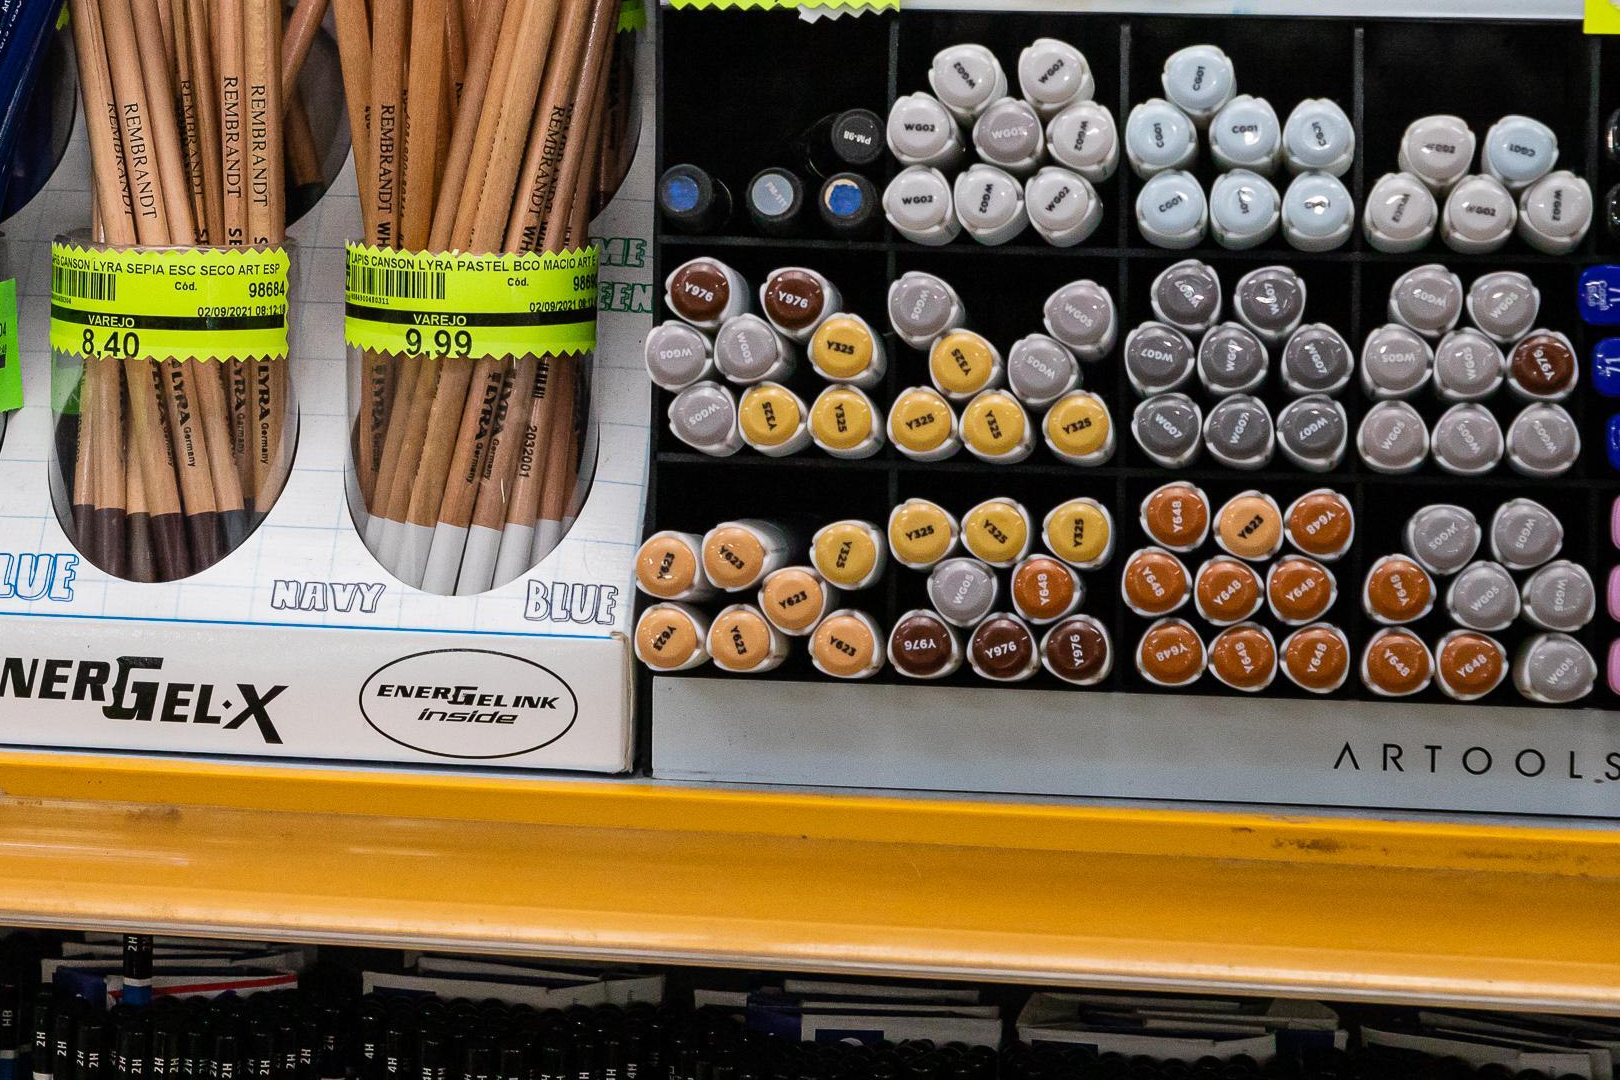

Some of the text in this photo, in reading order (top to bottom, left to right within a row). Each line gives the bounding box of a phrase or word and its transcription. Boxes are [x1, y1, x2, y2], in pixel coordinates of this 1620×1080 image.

[1038, 58, 1066, 86] WG02
[904, 122, 936, 133] WG02
[223, 76, 242, 199] REMBRANDT
[251, 84, 268, 207] REMBRANDT
[124, 102, 158, 219] REMBRANDT
[902, 195, 934, 206] WG02
[60, 257, 90, 271] CANSON
[93, 260, 123, 273] LYRA
[127, 263, 164, 275] SEPIA
[169, 264, 196, 276] ESC
[200, 264, 235, 276] SECO
[238, 264, 260, 276] ART
[263, 263, 281, 275] ESP
[351, 253, 370, 266] LAPIS
[371, 256, 415, 270] CANSON
[418, 259, 453, 271] LYRA
[457, 260, 509, 272] PASTEL
[513, 260, 540, 271] BCO
[543, 258, 576, 271] MACIO
[174, 281, 285, 298] Cód. 98684
[507, 277, 529, 287] Cód.
[684, 281, 714, 303] Y976
[778, 290, 809, 309] Y976
[88, 314, 135, 328] VAREJO
[197, 307, 252, 317] 02/09/2021
[412, 313, 467, 326] VAREJO
[82, 328, 140, 359] 8,40
[826, 340, 855, 355] Y325
[258, 365, 271, 465] LYRA Germany
[905, 413, 934, 430] Y325
[519, 425, 537, 478] 2032001
[905, 524, 935, 542] Y325
[718, 545, 746, 570] Y623
[1213, 578, 1243, 605] Y648
[1286, 577, 1316, 603] Y648
[272, 579, 618, 625] NAVY BLUE
[778, 590, 808, 610] Y623
[985, 641, 1016, 660] Y976
[512, 693, 558, 709] INK
[418, 706, 518, 725] inside
[35, 1030, 47, 1048] 2H
